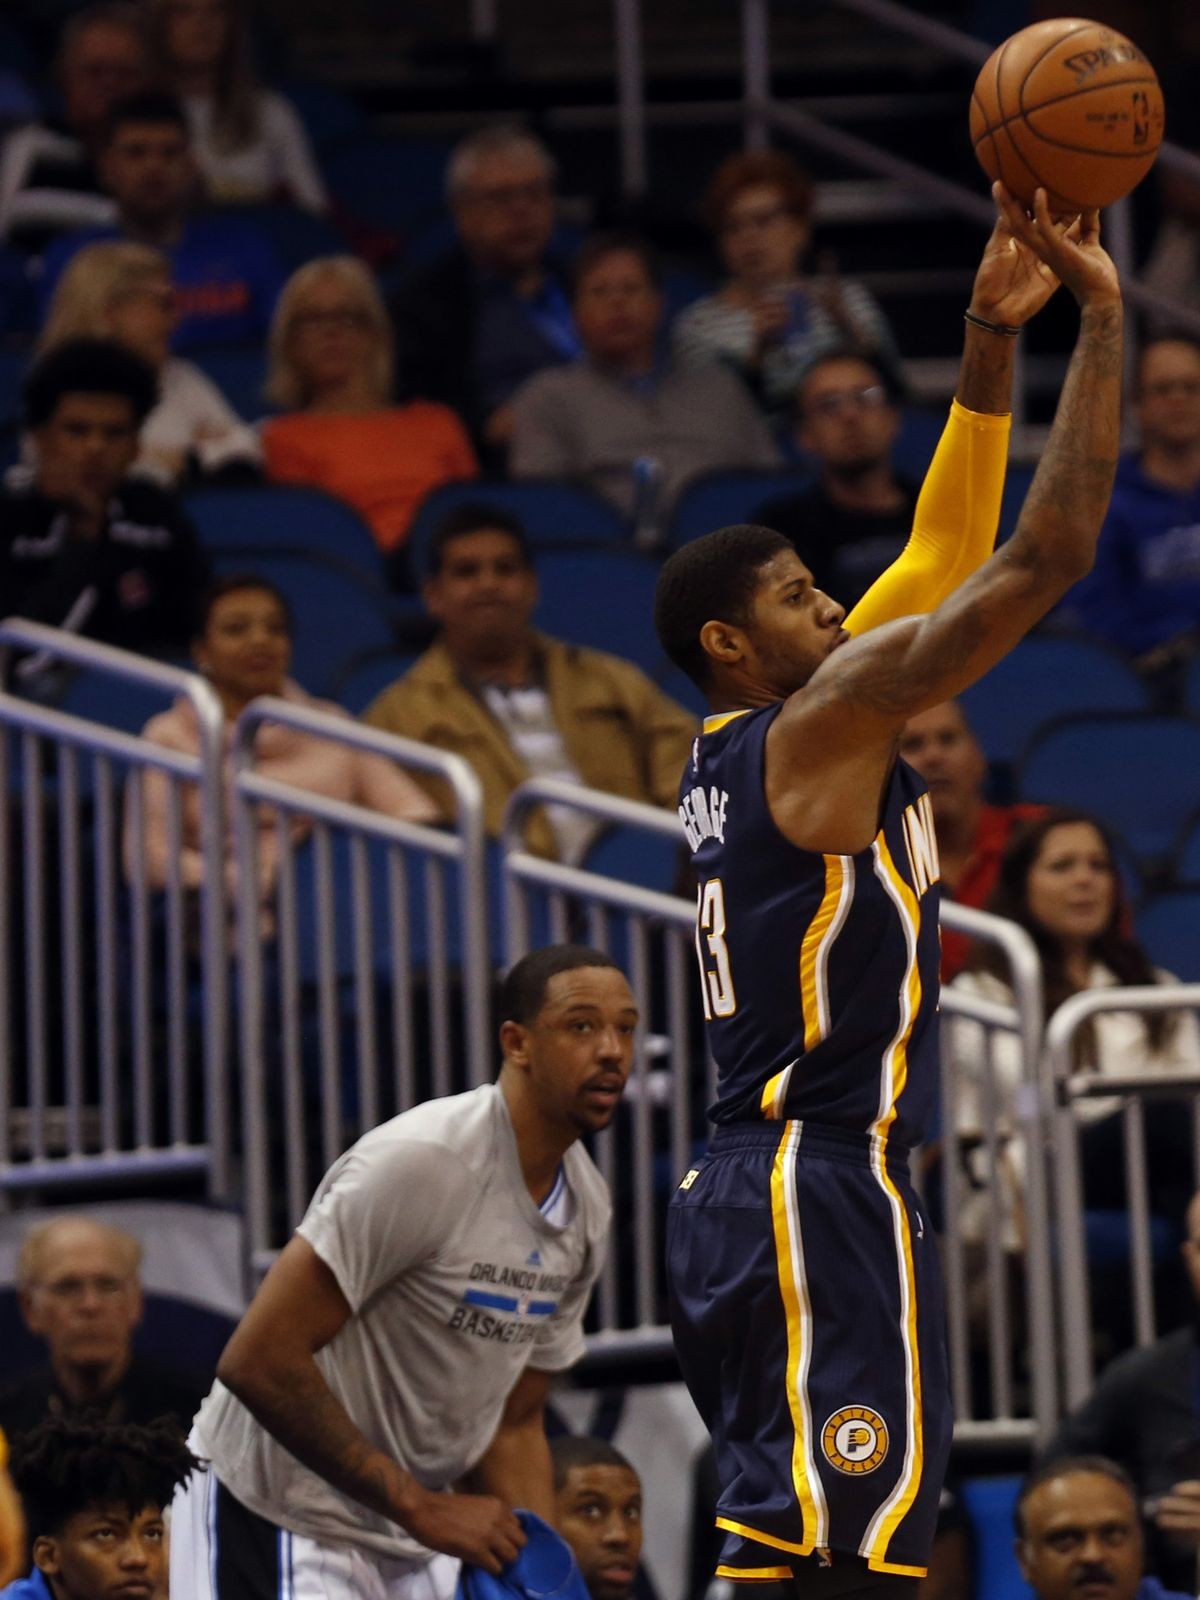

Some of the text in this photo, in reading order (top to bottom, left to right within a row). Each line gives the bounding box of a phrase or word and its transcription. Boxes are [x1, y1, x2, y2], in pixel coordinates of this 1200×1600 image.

[678, 786, 729, 853] GEORGE
[469, 1262, 537, 1290] ORLANDO
[825, 1410, 884, 1438] INDIANA
[829, 1450, 883, 1472] PACERS
